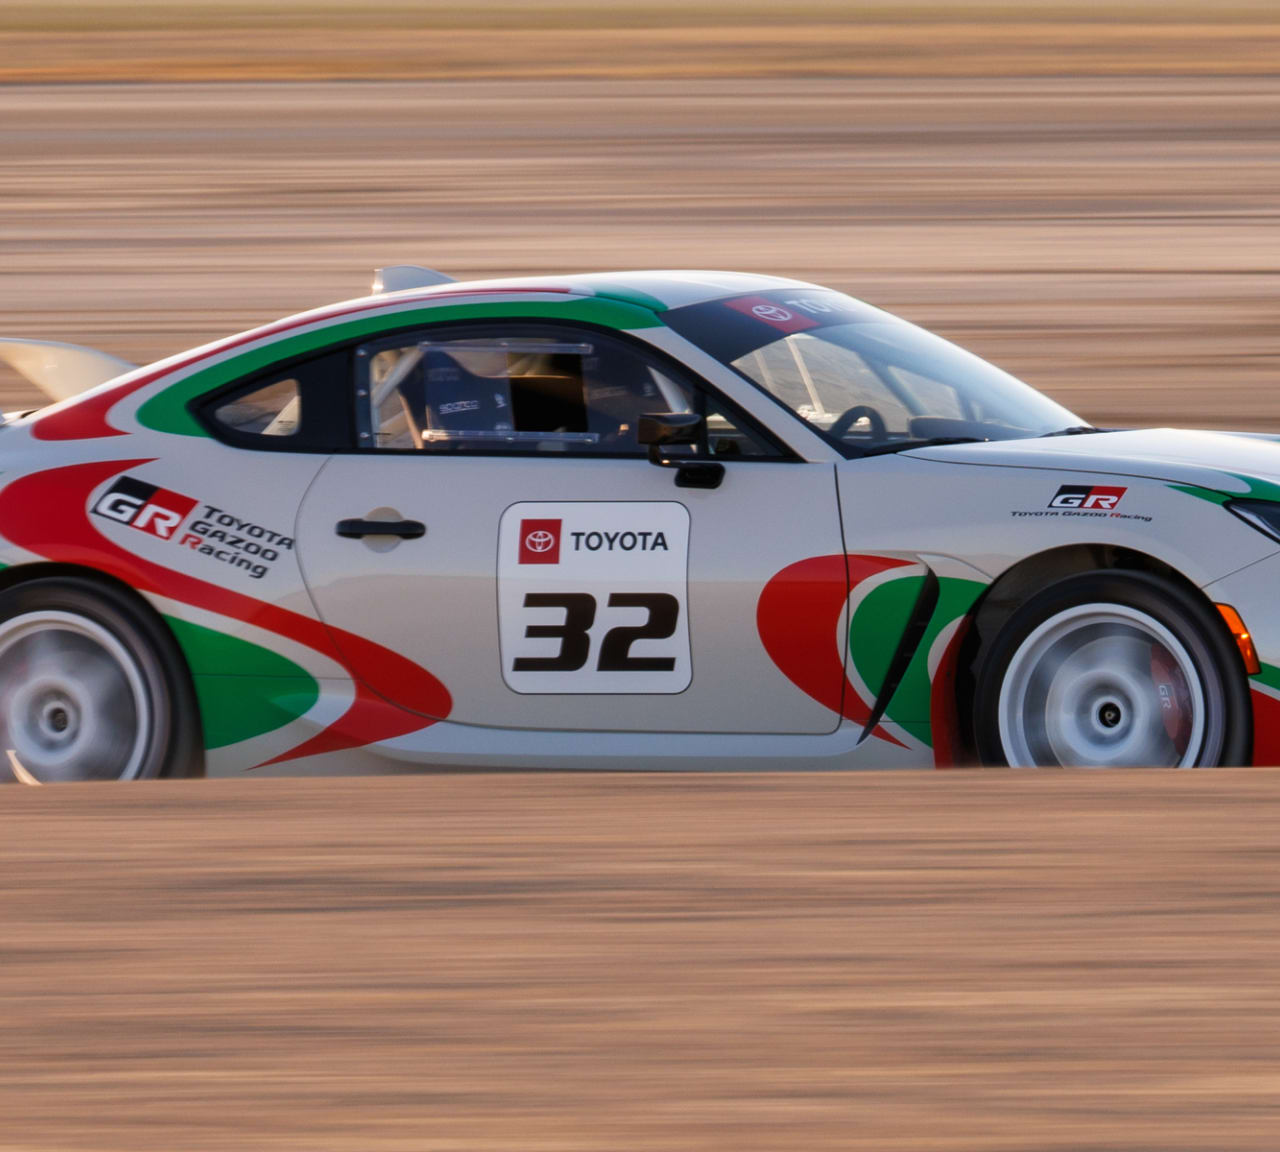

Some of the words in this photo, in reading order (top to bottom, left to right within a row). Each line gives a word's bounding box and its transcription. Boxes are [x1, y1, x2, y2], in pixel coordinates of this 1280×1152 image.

[95, 492, 183, 538] GR
[1051, 493, 1119, 509] GR
[1109, 512, 1153, 522] Racing
[188, 519, 280, 562] GAZOO
[204, 504, 296, 551] TOYOTA
[570, 531, 669, 551] TOYOTA
[179, 533, 270, 579] Racing
[512, 592, 680, 672] 32
